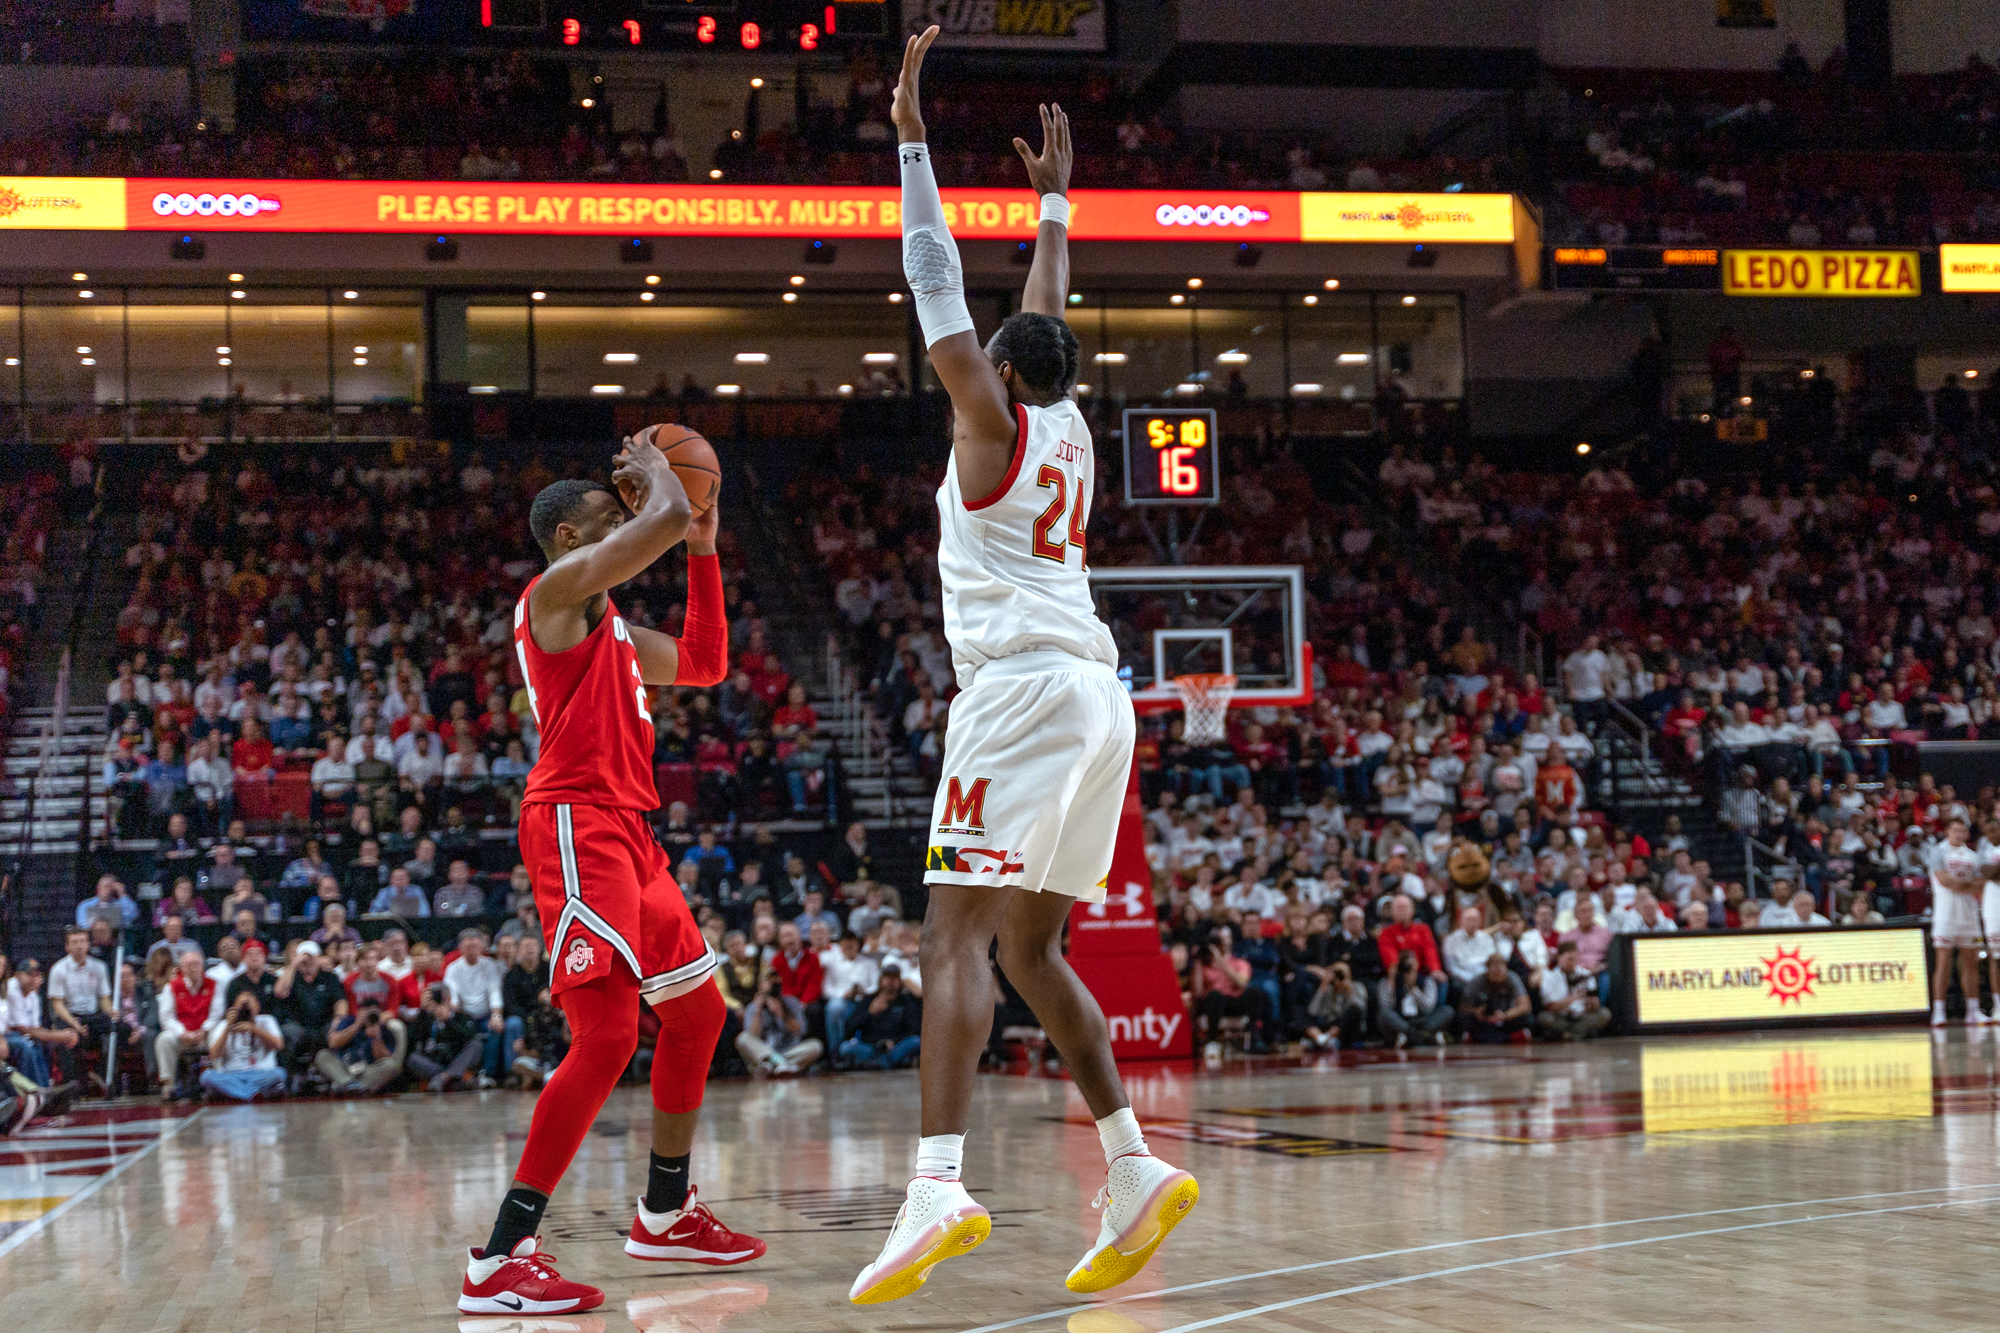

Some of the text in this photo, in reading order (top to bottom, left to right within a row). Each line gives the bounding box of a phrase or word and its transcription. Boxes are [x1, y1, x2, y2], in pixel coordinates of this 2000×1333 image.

[562, 18, 580, 45] 3
[623, 20, 641, 45] 7
[698, 16, 717, 43] 2
[740, 22, 760, 49] 0
[800, 23, 819, 50] 2
[377, 195, 491, 222] PLEASE
[497, 196, 573, 223] PLAY
[579, 197, 784, 226] RESPONSIBLY.
[789, 199, 873, 226] MUST
[878, 200, 903, 227] B
[960, 201, 1003, 228] TO
[1006, 202, 1079, 228] PLY
[1728, 255, 1916, 291] LEDO PIZZA
[1147, 419, 1206, 449] 5:10
[1159, 446, 1199, 495] 16
[1032, 463, 1087, 572] 24
[939, 776, 992, 829] M
[1647, 966, 1763, 991] MARYLAND
[1816, 961, 1908, 985] LOTTERY
[1108, 1007, 1182, 1049] nity
